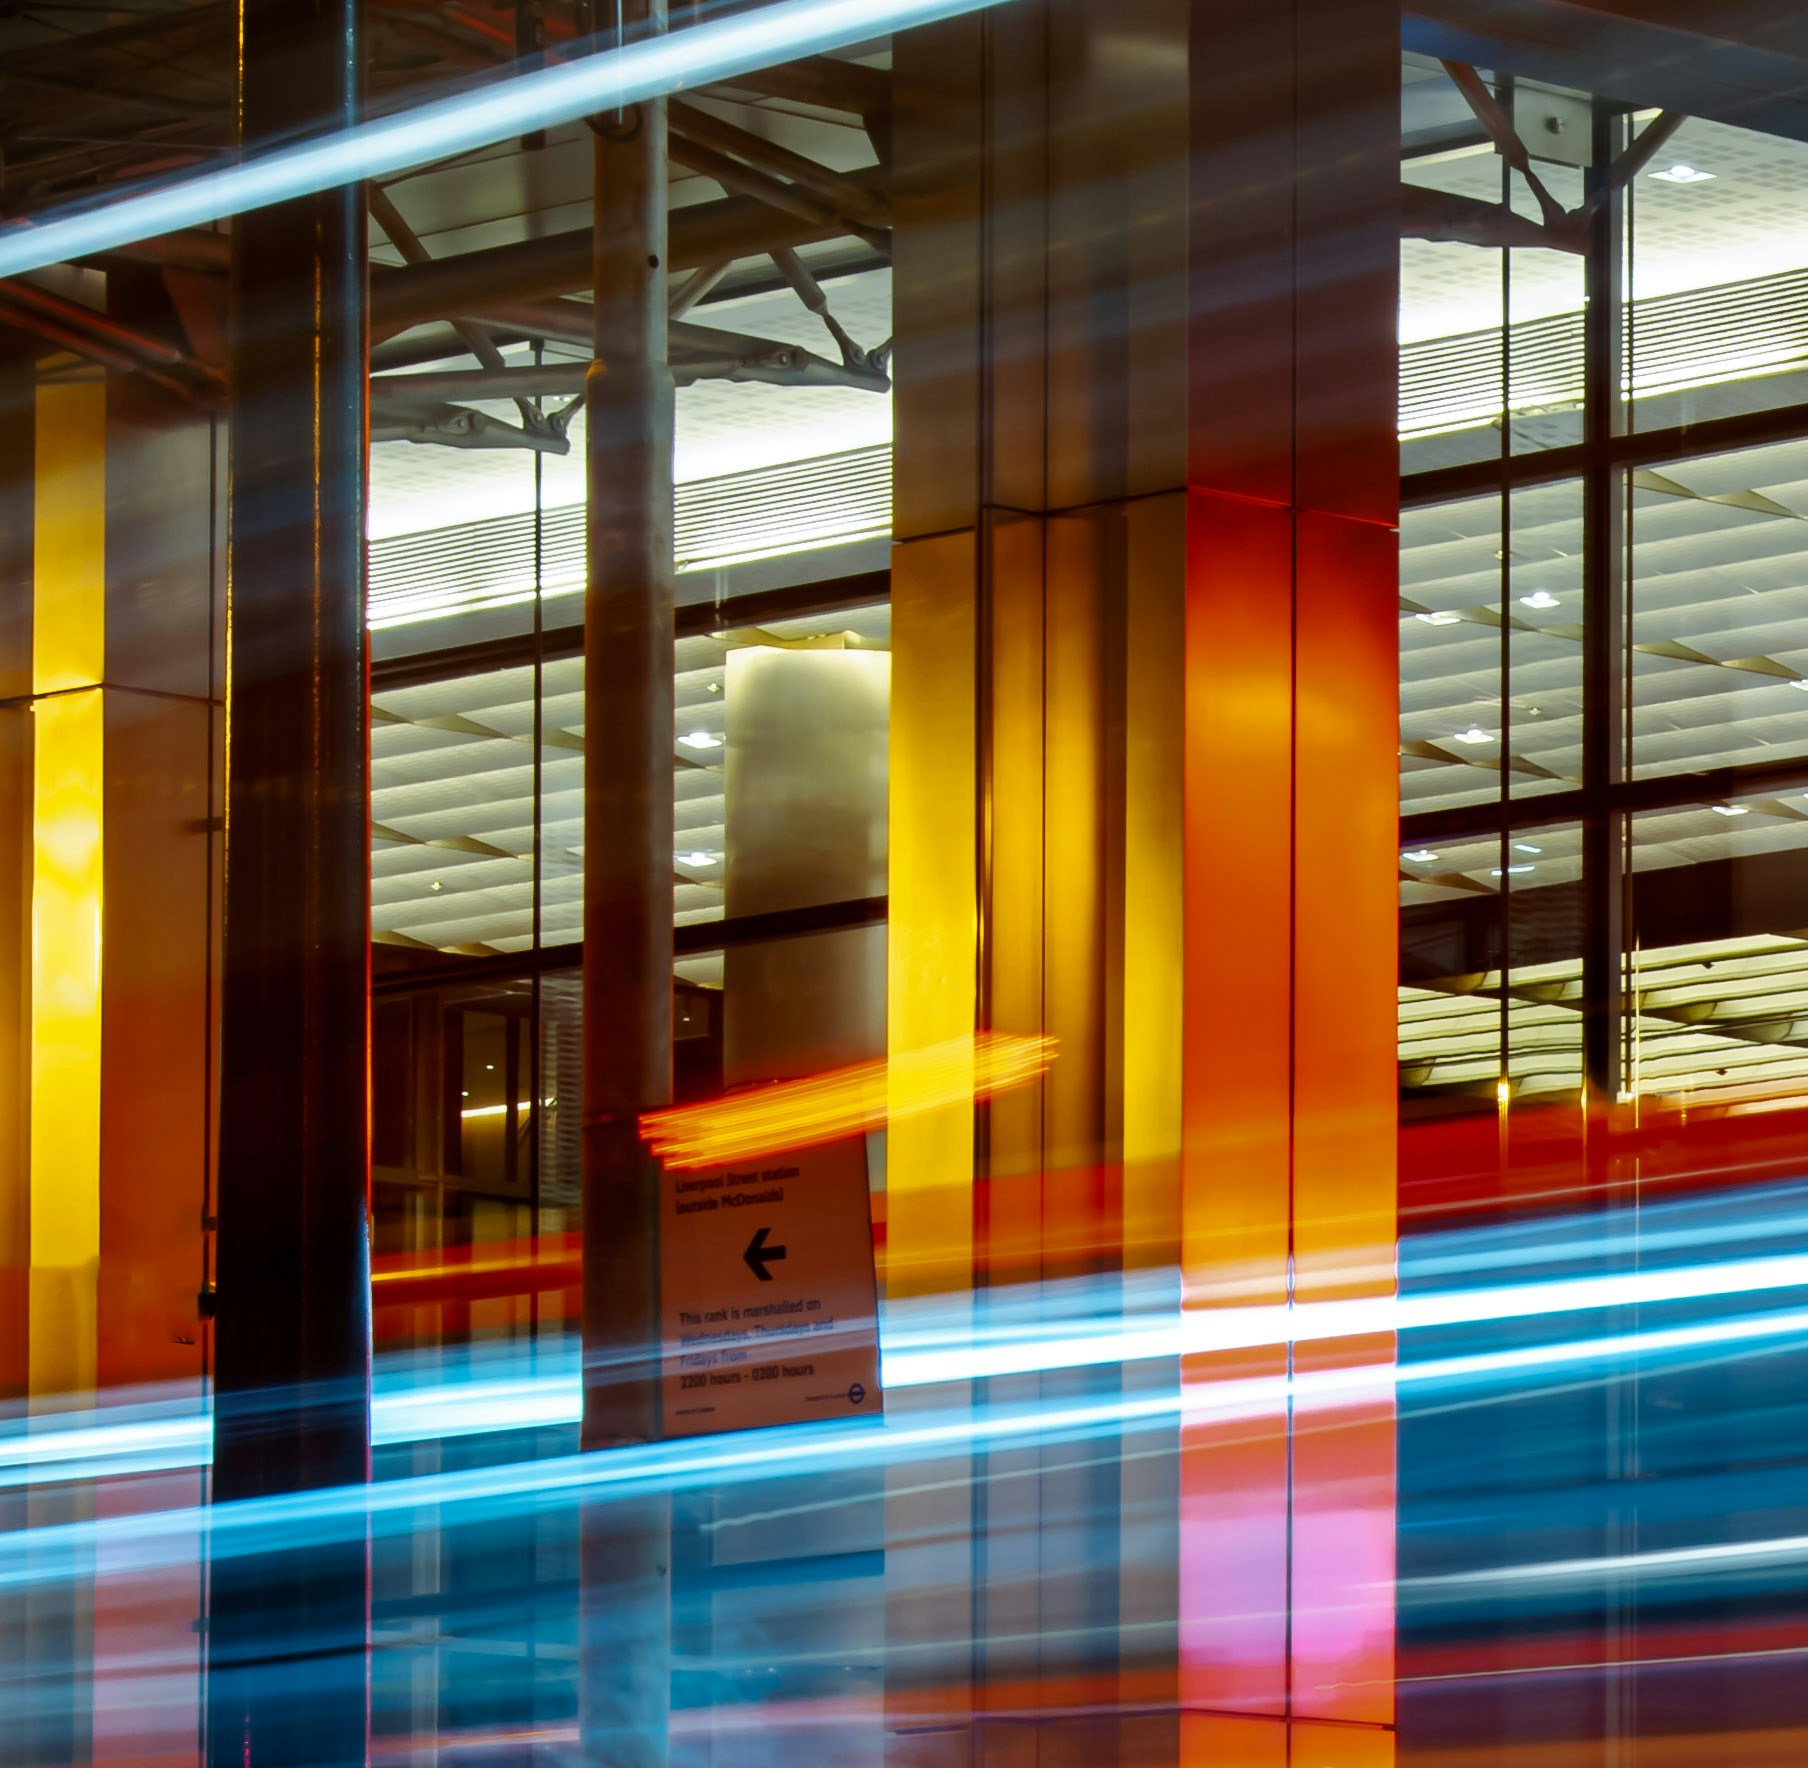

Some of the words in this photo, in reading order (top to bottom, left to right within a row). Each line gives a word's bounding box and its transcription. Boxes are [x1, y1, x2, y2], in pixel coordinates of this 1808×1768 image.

[675, 1175, 724, 1194] Liverpool
[726, 1171, 759, 1187] Street
[761, 1167, 800, 1181] station
[680, 1312, 702, 1325] This
[704, 1307, 728, 1321] rank
[731, 1307, 740, 1320] is
[743, 1299, 803, 1318] marshalled
[806, 1299, 821, 1311] on
[813, 1317, 834, 1333] and
[680, 1352, 718, 1368] Fridays
[721, 1350, 748, 1363] from
[680, 1372, 706, 1390] 2200
[709, 1370, 741, 1386] hours
[752, 1366, 779, 1382] 0200
[782, 1363, 814, 1378] hours
